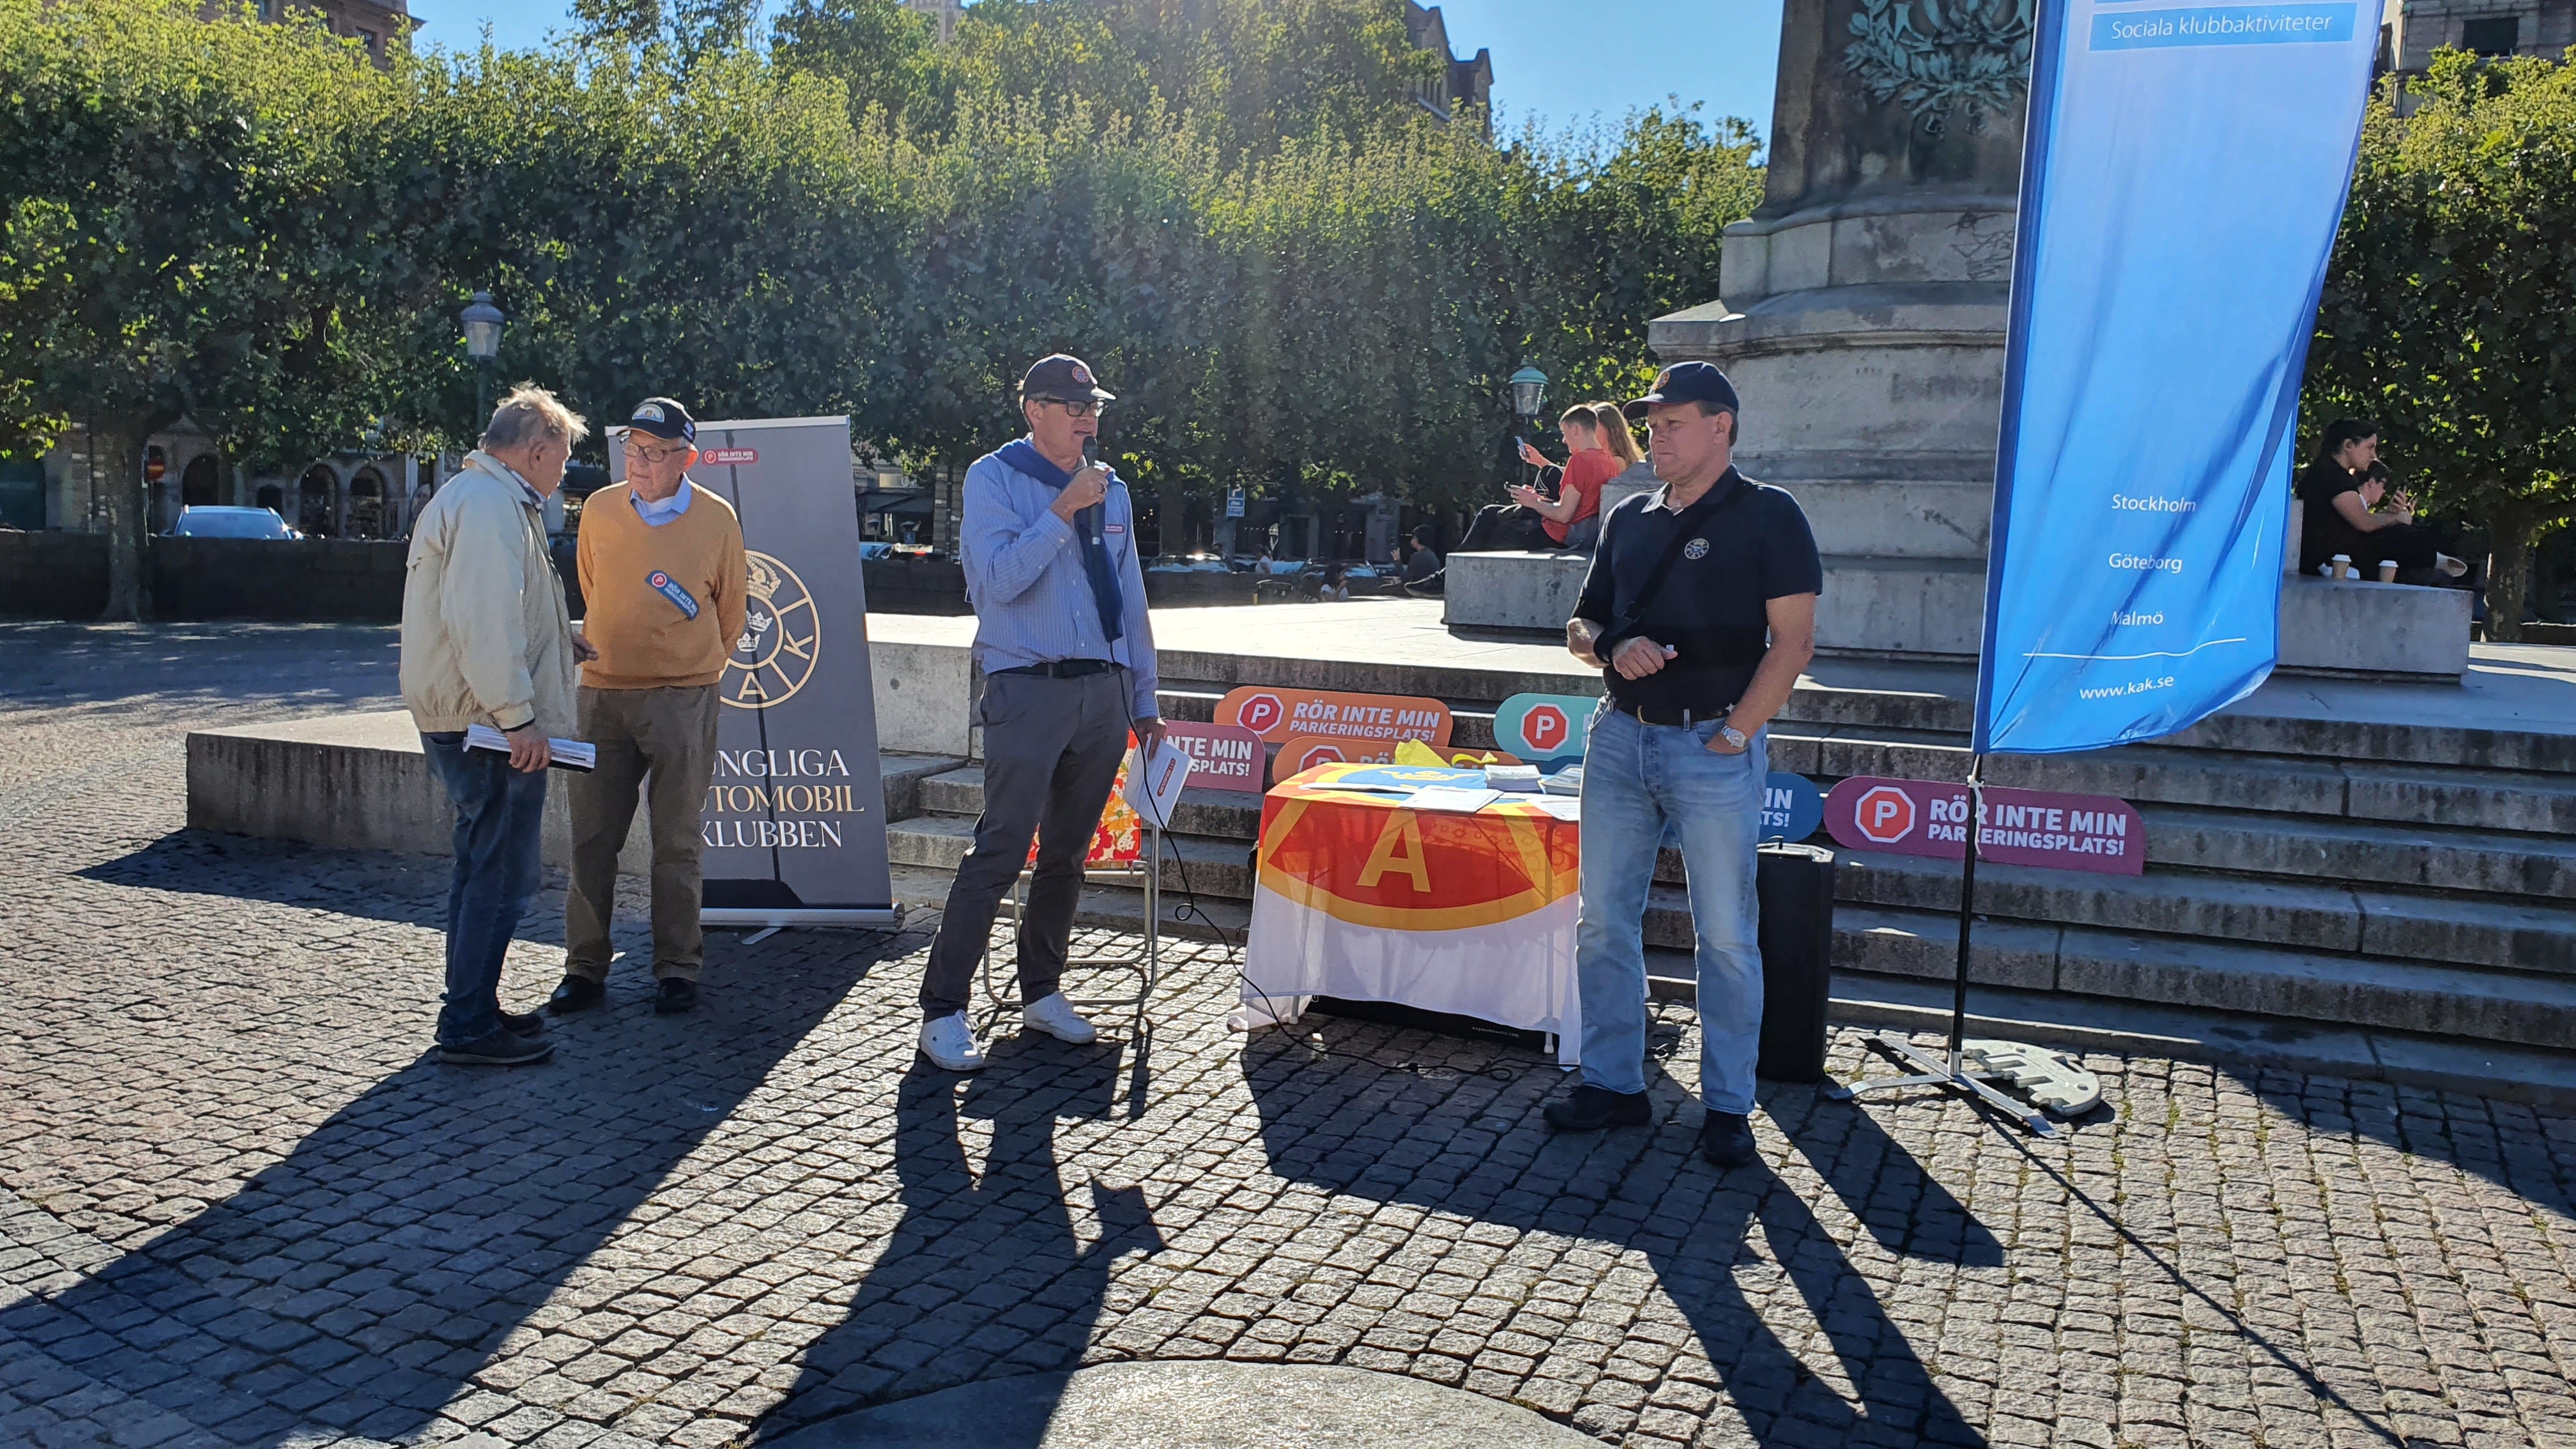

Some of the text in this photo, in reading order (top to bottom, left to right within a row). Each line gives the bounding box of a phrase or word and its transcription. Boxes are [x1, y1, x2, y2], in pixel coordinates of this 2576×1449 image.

[2111, 13, 2333, 40] Sociala klubbaktiviteter
[2111, 494, 2196, 512] Stockholm
[2108, 553, 2182, 574] Göteborg
[2110, 610, 2164, 625] Malmö
[2079, 675, 2175, 699] www.kak.se
[1250, 703, 1271, 724] P
[1293, 698, 1441, 728] RÖR INTE MIN
[1289, 720, 1436, 742] PARKERINGSPLATS!
[1535, 715, 1556, 739] P
[1165, 735, 1253, 760] NTE MIN
[712, 749, 850, 778] NGLIGA
[700, 785, 865, 813] TOMOBIL
[1874, 801, 1897, 827] P
[1929, 794, 2127, 836] RÖR INTE MIN
[1928, 824, 2125, 856] PARERINGSPLATS!
